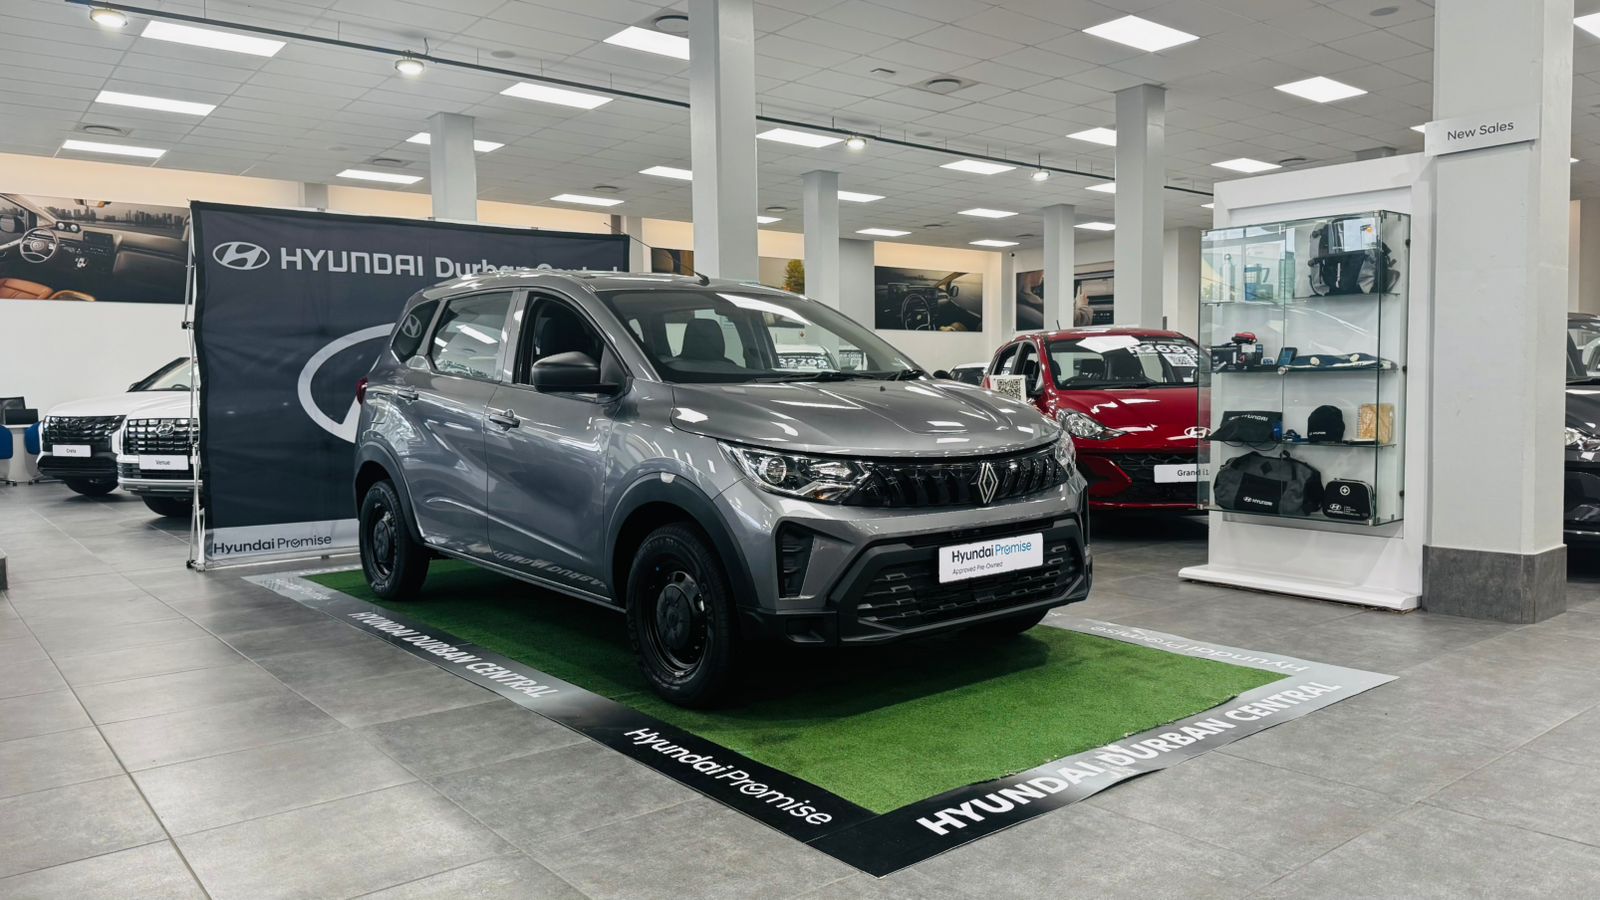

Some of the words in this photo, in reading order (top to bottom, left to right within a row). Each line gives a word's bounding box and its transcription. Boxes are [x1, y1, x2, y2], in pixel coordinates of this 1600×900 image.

[1447, 129, 1476, 140] New
[1479, 122, 1514, 135] Sales
[280, 247, 424, 277] HYUNDAI
[1177, 469, 1201, 477] Grand
[213, 538, 275, 554] Hyundai
[277, 535, 332, 549] Promise
[951, 545, 994, 564] Hyundai
[995, 541, 1032, 556] Promise
[952, 566, 976, 575] Approved
[347, 611, 421, 637] HYUNDAI
[401, 635, 482, 664] DURBAN
[465, 661, 559, 698] CENTRAL
[1190, 645, 1310, 672] Hyundai
[915, 760, 1106, 836] HYUNDAI
[1096, 718, 1237, 766] DURBAN
[1225, 681, 1342, 721] CENTRAL
[623, 728, 735, 780] Hyundai
[714, 769, 833, 825] Promise
